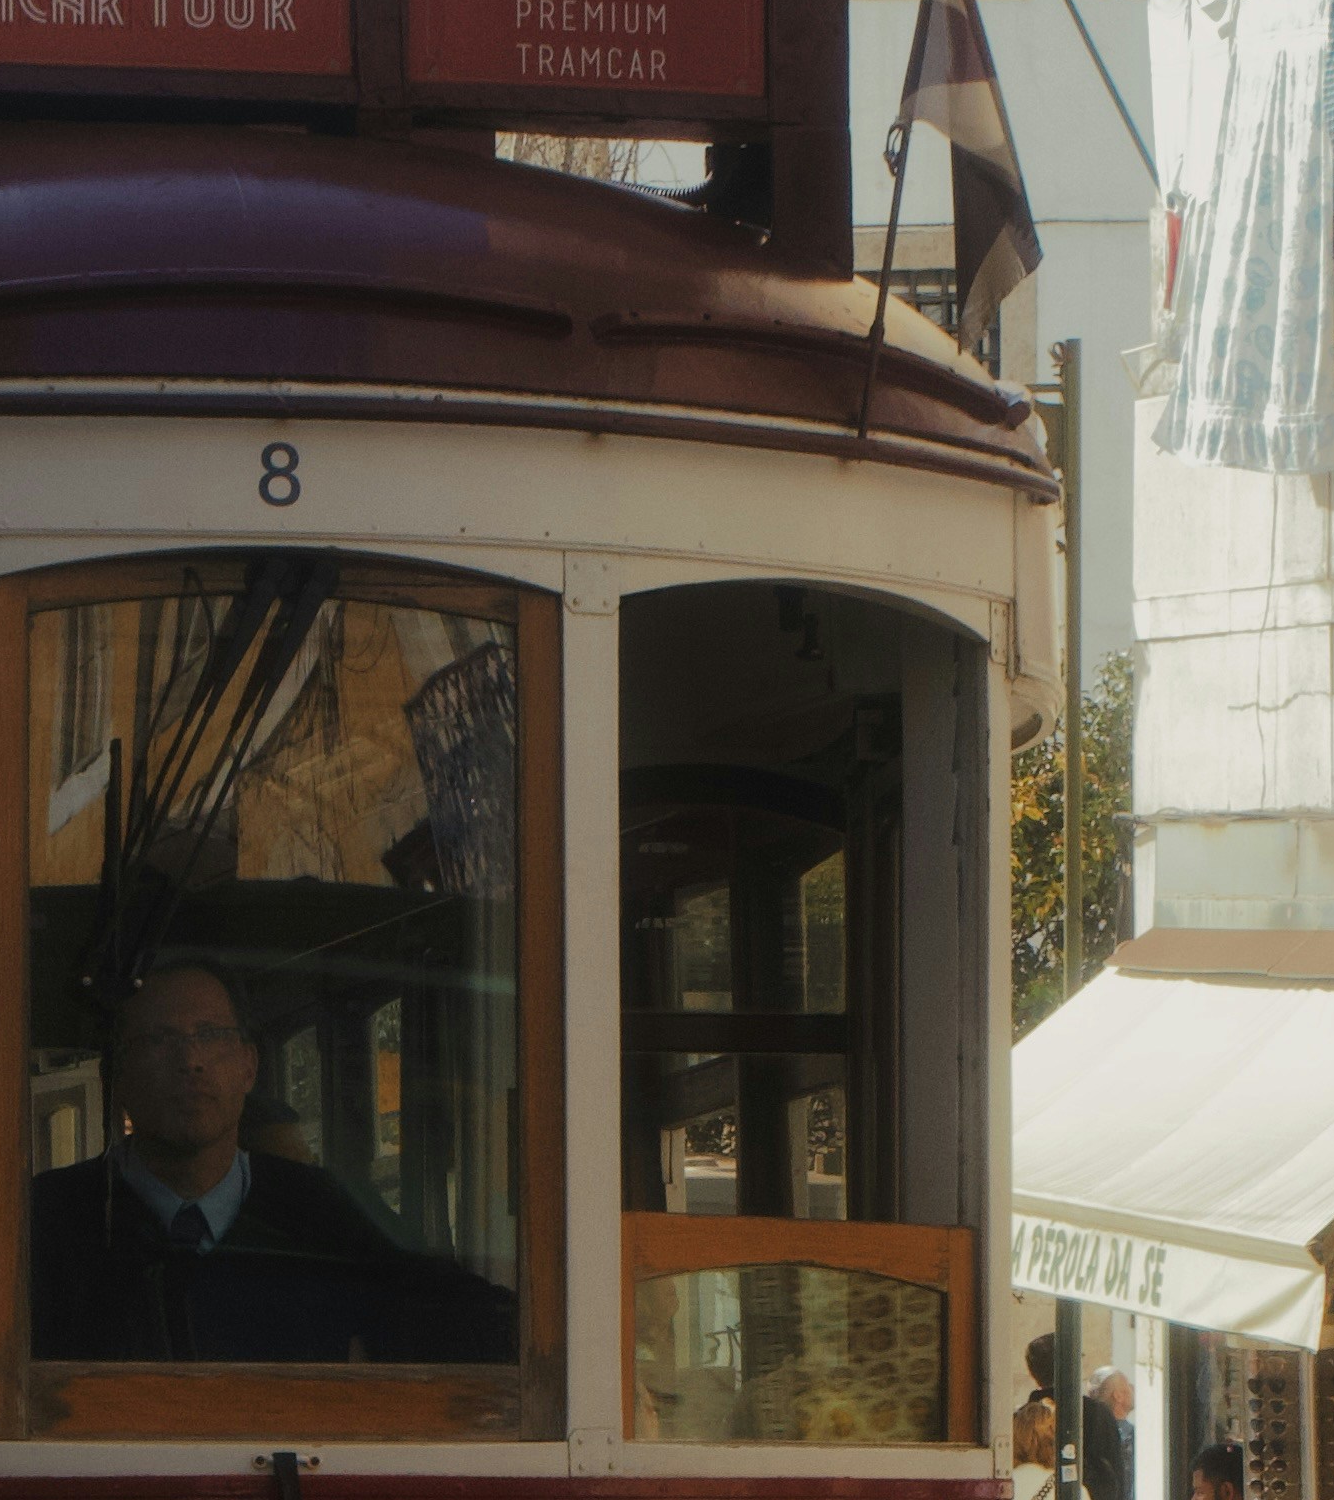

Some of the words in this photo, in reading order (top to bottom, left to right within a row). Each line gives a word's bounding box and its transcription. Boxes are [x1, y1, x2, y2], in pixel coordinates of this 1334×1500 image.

[516, 43, 666, 81] TRAMCAR
[258, 441, 301, 507] 8
[1027, 1219, 1100, 1294] PÉROLA
[1104, 1237, 1132, 1301] DA
